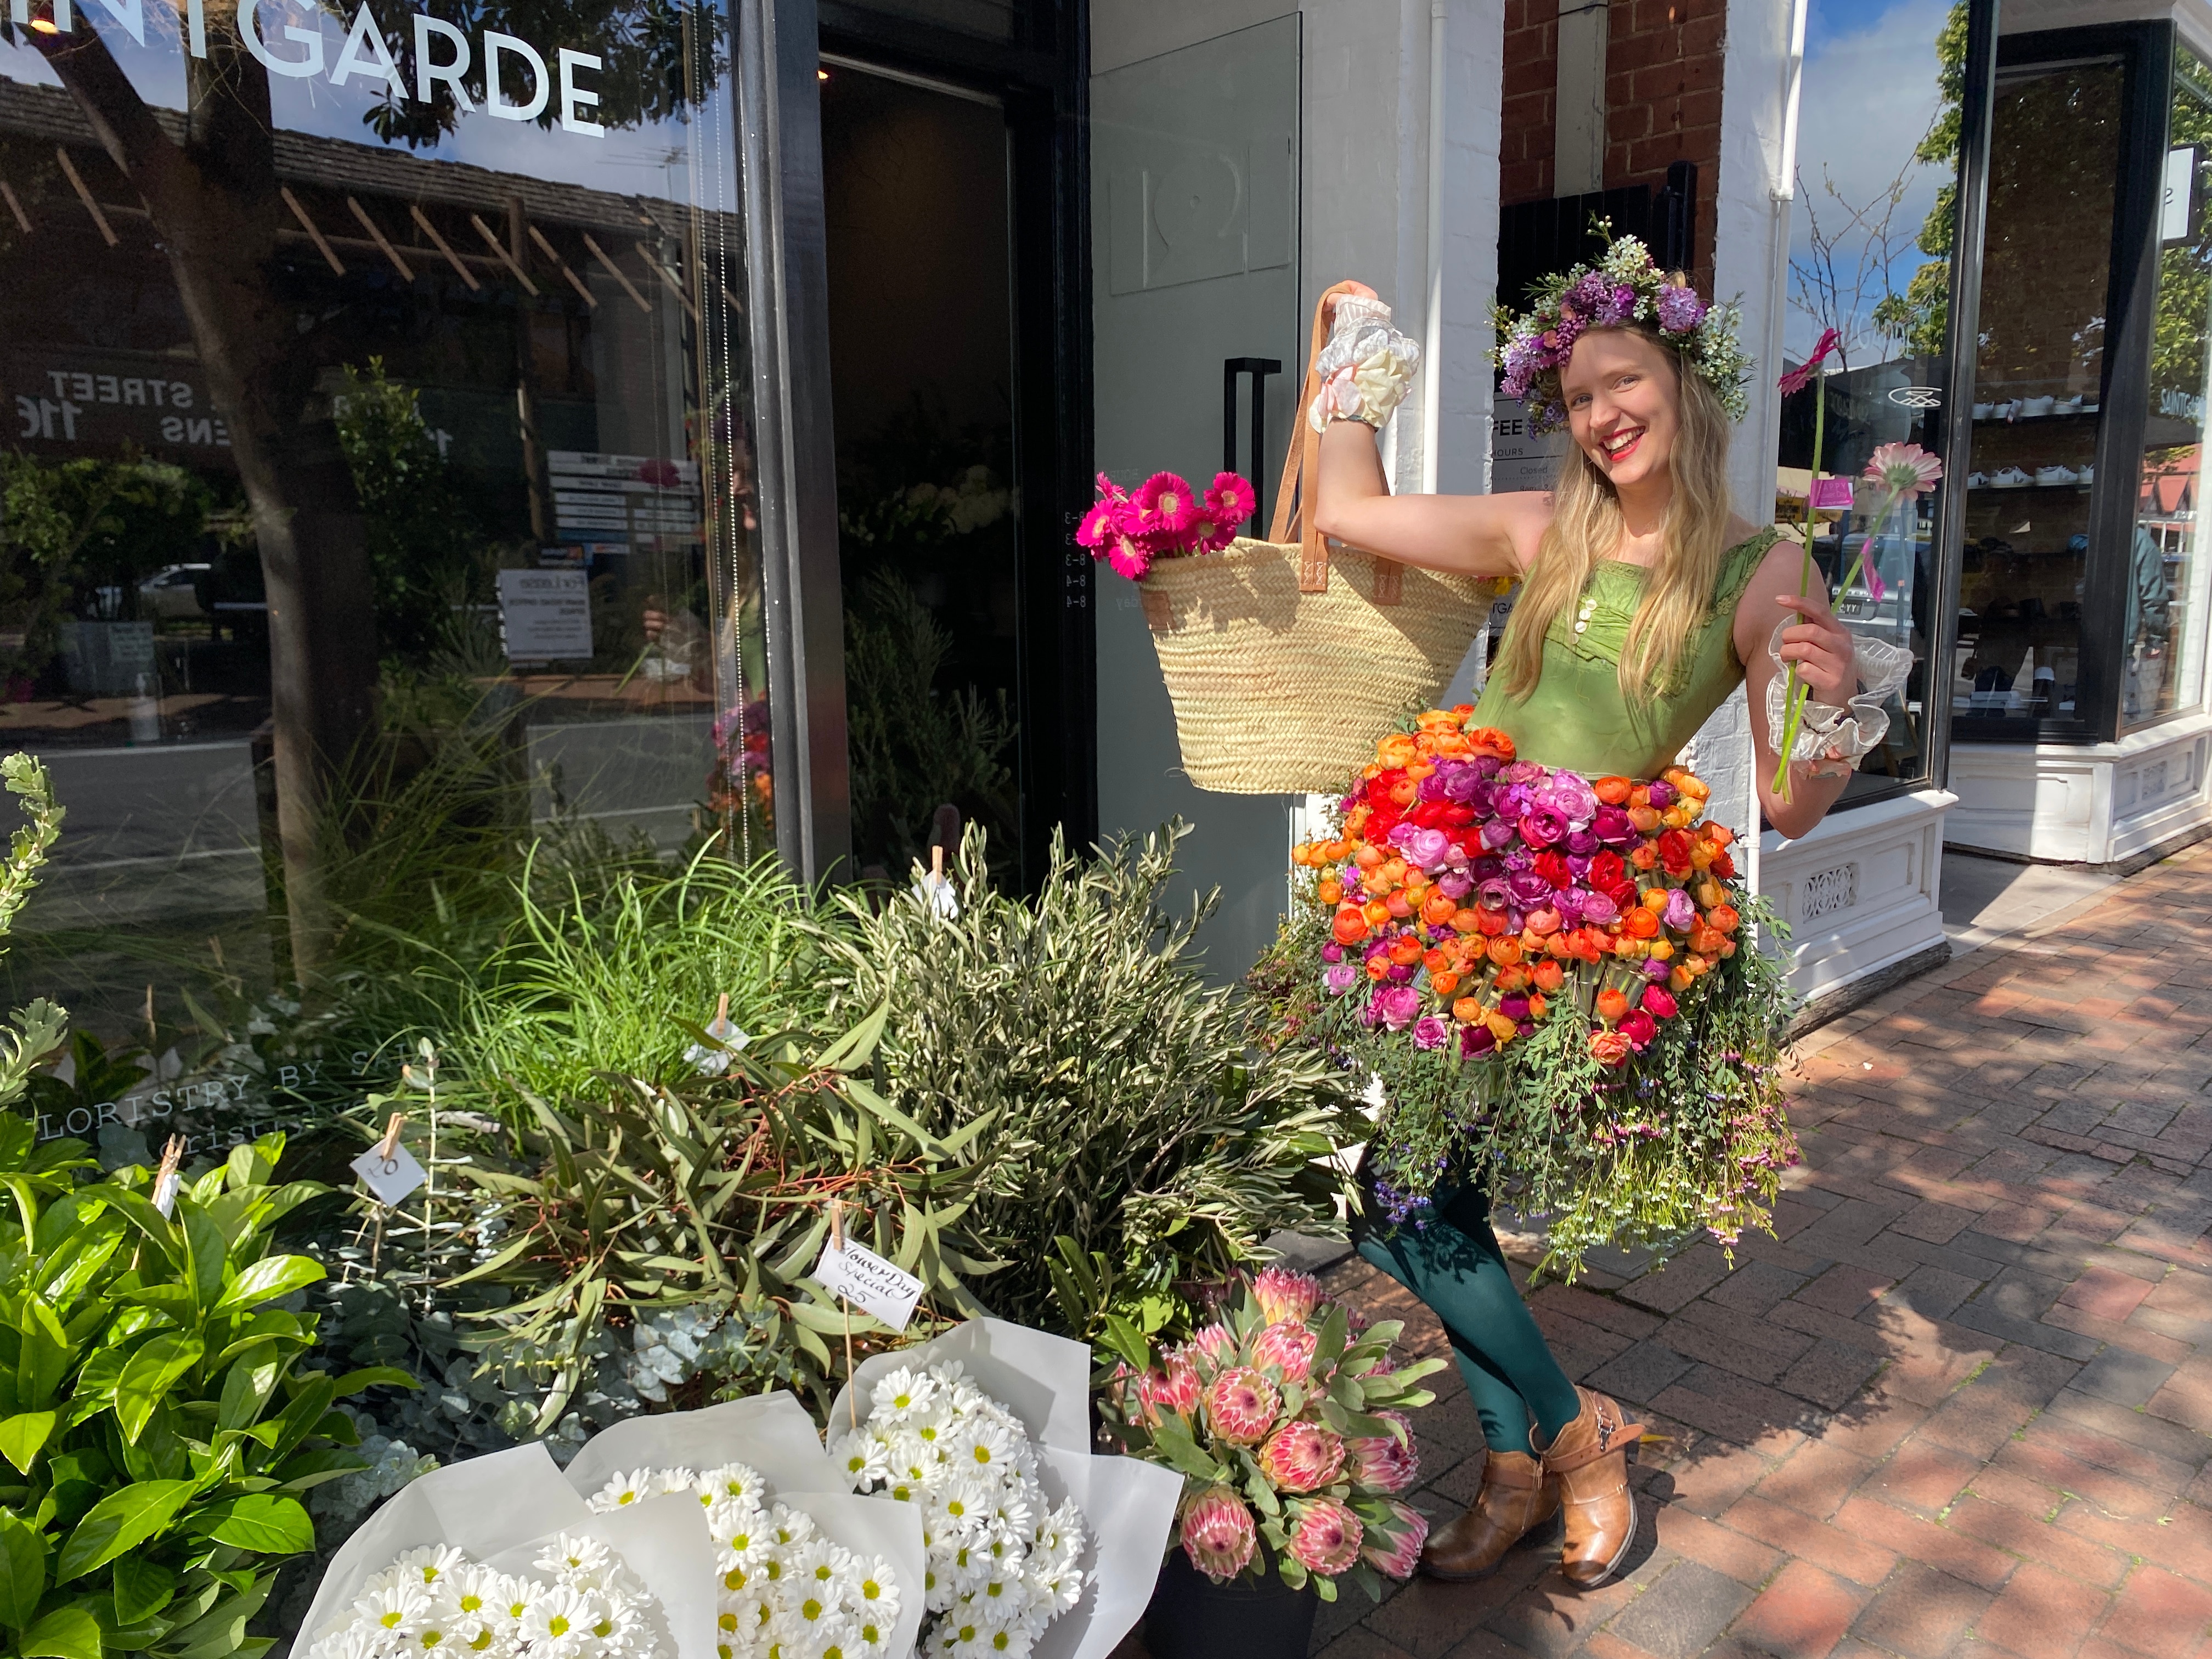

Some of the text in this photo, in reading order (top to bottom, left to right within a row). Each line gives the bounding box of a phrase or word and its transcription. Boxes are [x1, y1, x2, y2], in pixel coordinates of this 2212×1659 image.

[10, 0, 605, 138] NTGARDE
[1520, 466, 1548, 475] Closed
[27, 1074, 250, 1141] LORISTRY
[278, 1060, 324, 1090] BY
[367, 1154, 399, 1178] 20
[838, 1261, 895, 1298] Special
[884, 1273, 917, 1300] Day
[837, 1283, 878, 1304] 25
